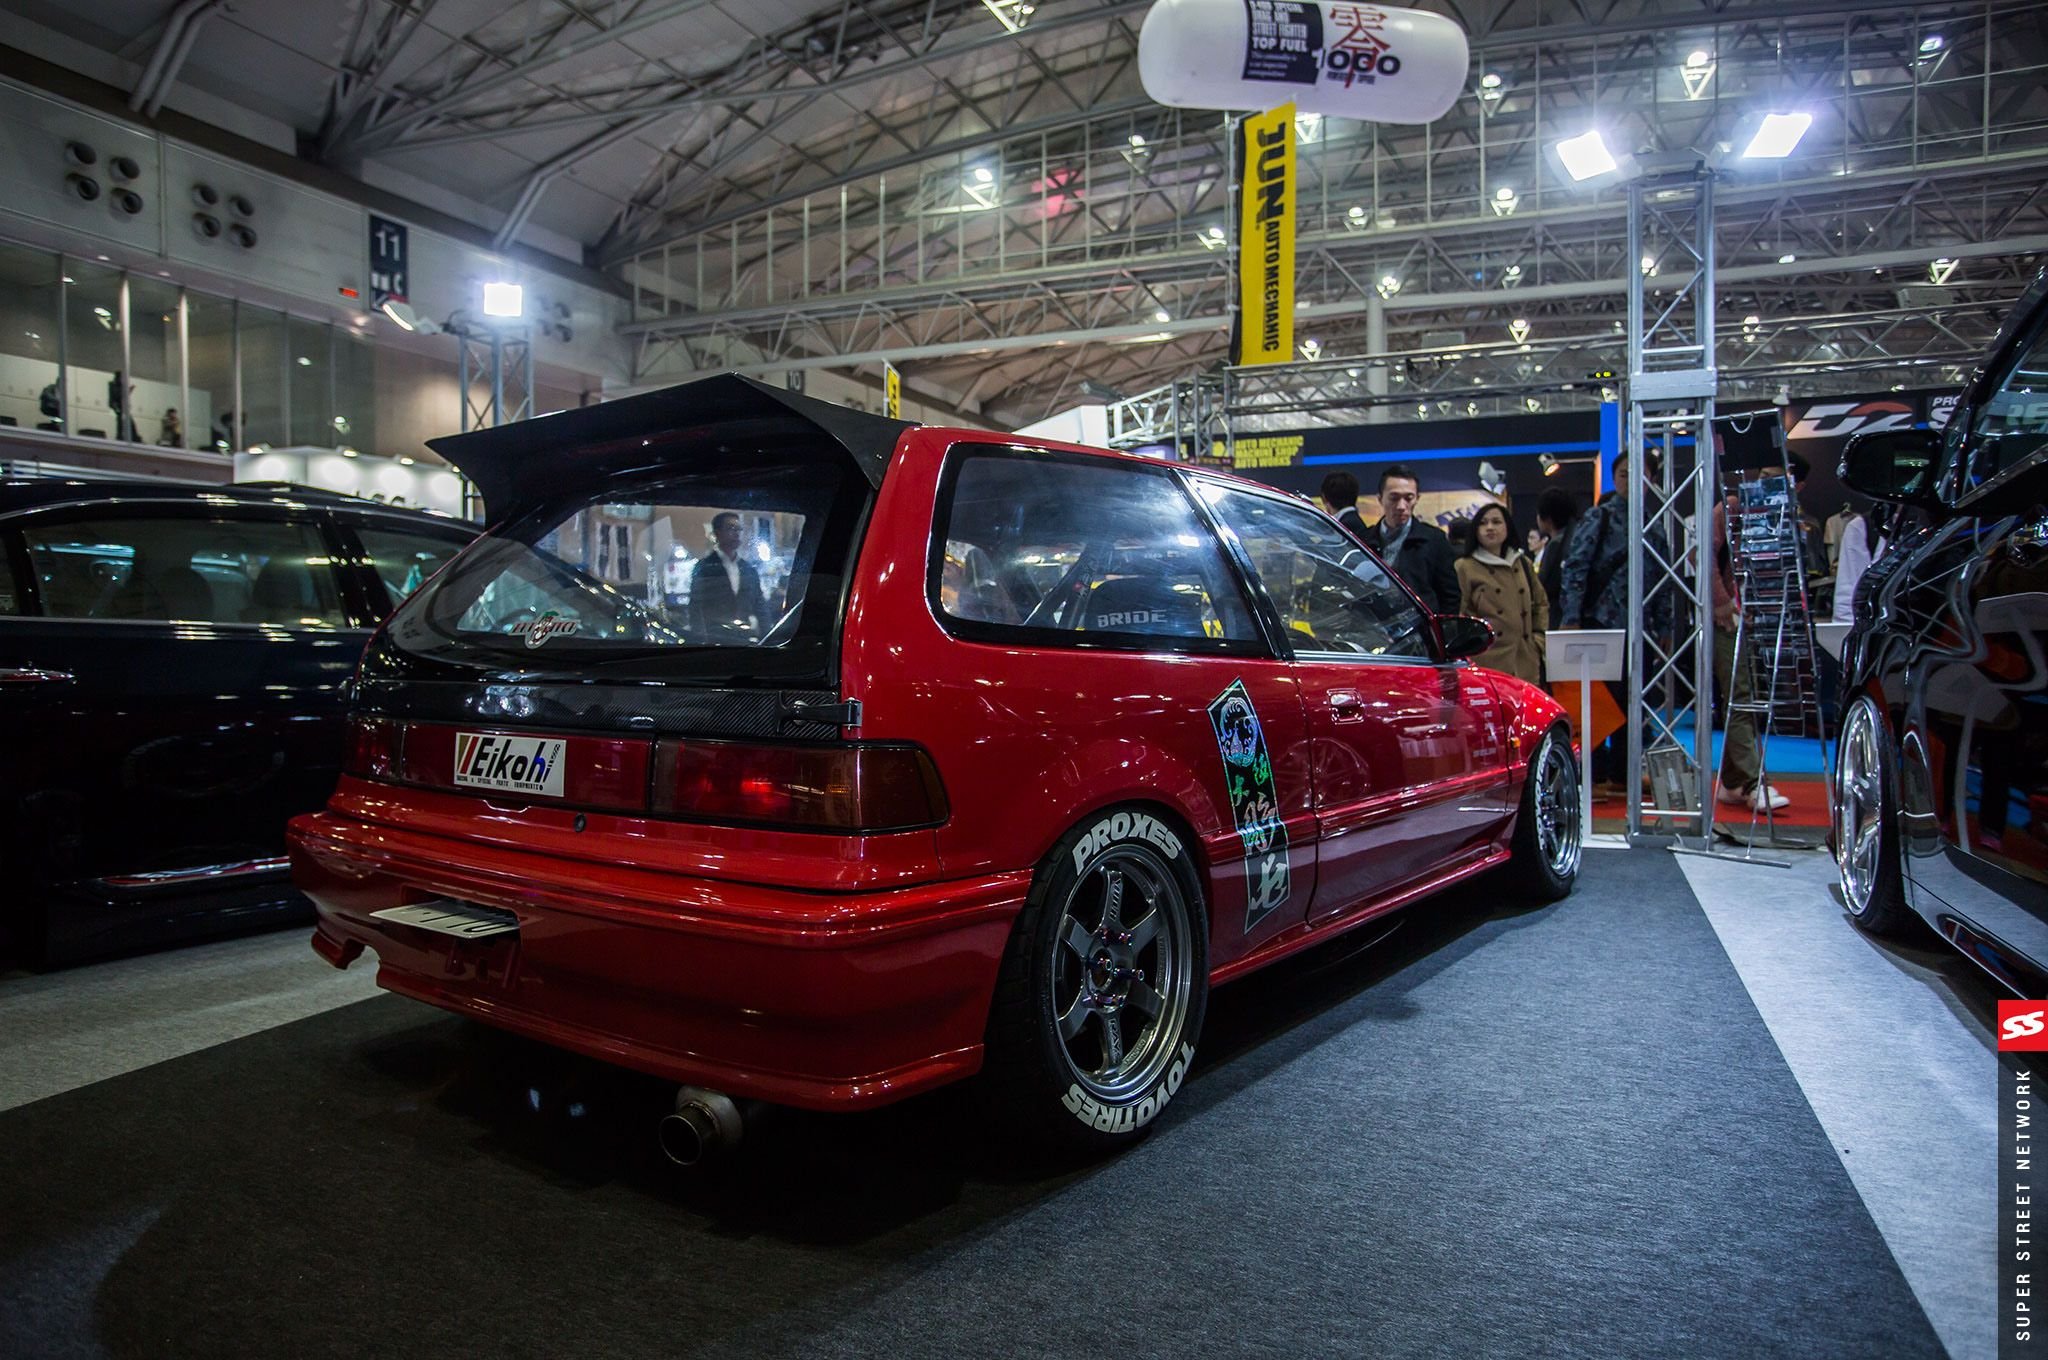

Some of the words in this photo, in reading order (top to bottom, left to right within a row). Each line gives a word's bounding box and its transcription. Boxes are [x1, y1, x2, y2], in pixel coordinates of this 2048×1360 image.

[1252, 36, 1278, 49] TOP
[1280, 38, 1307, 51] FUEL
[1256, 122, 1286, 224] JUN
[376, 230, 401, 261] 11
[1265, 220, 1281, 262] AUTO
[1264, 264, 1280, 353] MECHANIC
[788, 369, 801, 392] 10
[1235, 439, 1257, 449] AUTO
[1259, 435, 1304, 447] MECHANIC
[1235, 458, 1257, 469] AUTO
[1258, 457, 1291, 468] WORKS
[1097, 609, 1168, 628] BRIDE
[1072, 812, 1182, 876] PROXES
[1136, 1041, 1196, 1128] TOYO
[1060, 1083, 1136, 1133] TIRES
